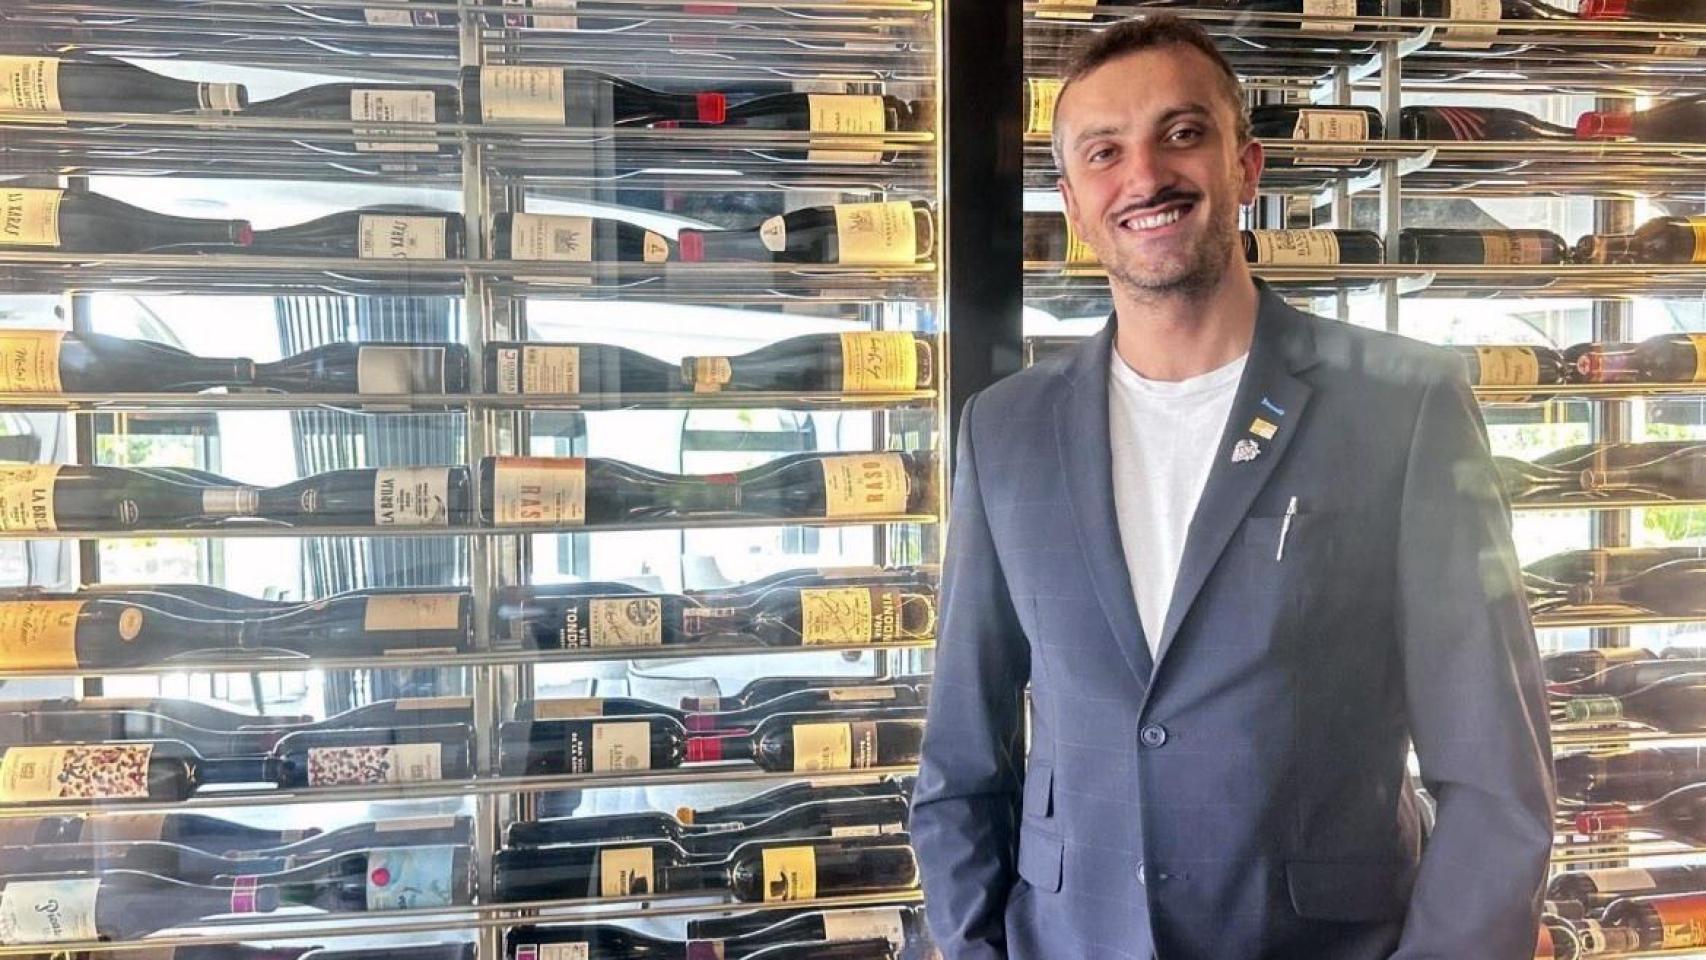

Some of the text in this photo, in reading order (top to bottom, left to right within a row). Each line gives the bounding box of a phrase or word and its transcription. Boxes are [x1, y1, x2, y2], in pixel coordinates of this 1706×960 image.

[32, 488, 47, 502] LA
[380, 478, 394, 524] LA BRUJA
[520, 485, 541, 521] RAS
[862, 461, 884, 503] RASO
[566, 607, 578, 649] TONDO
[883, 592, 894, 642] NDONIA
